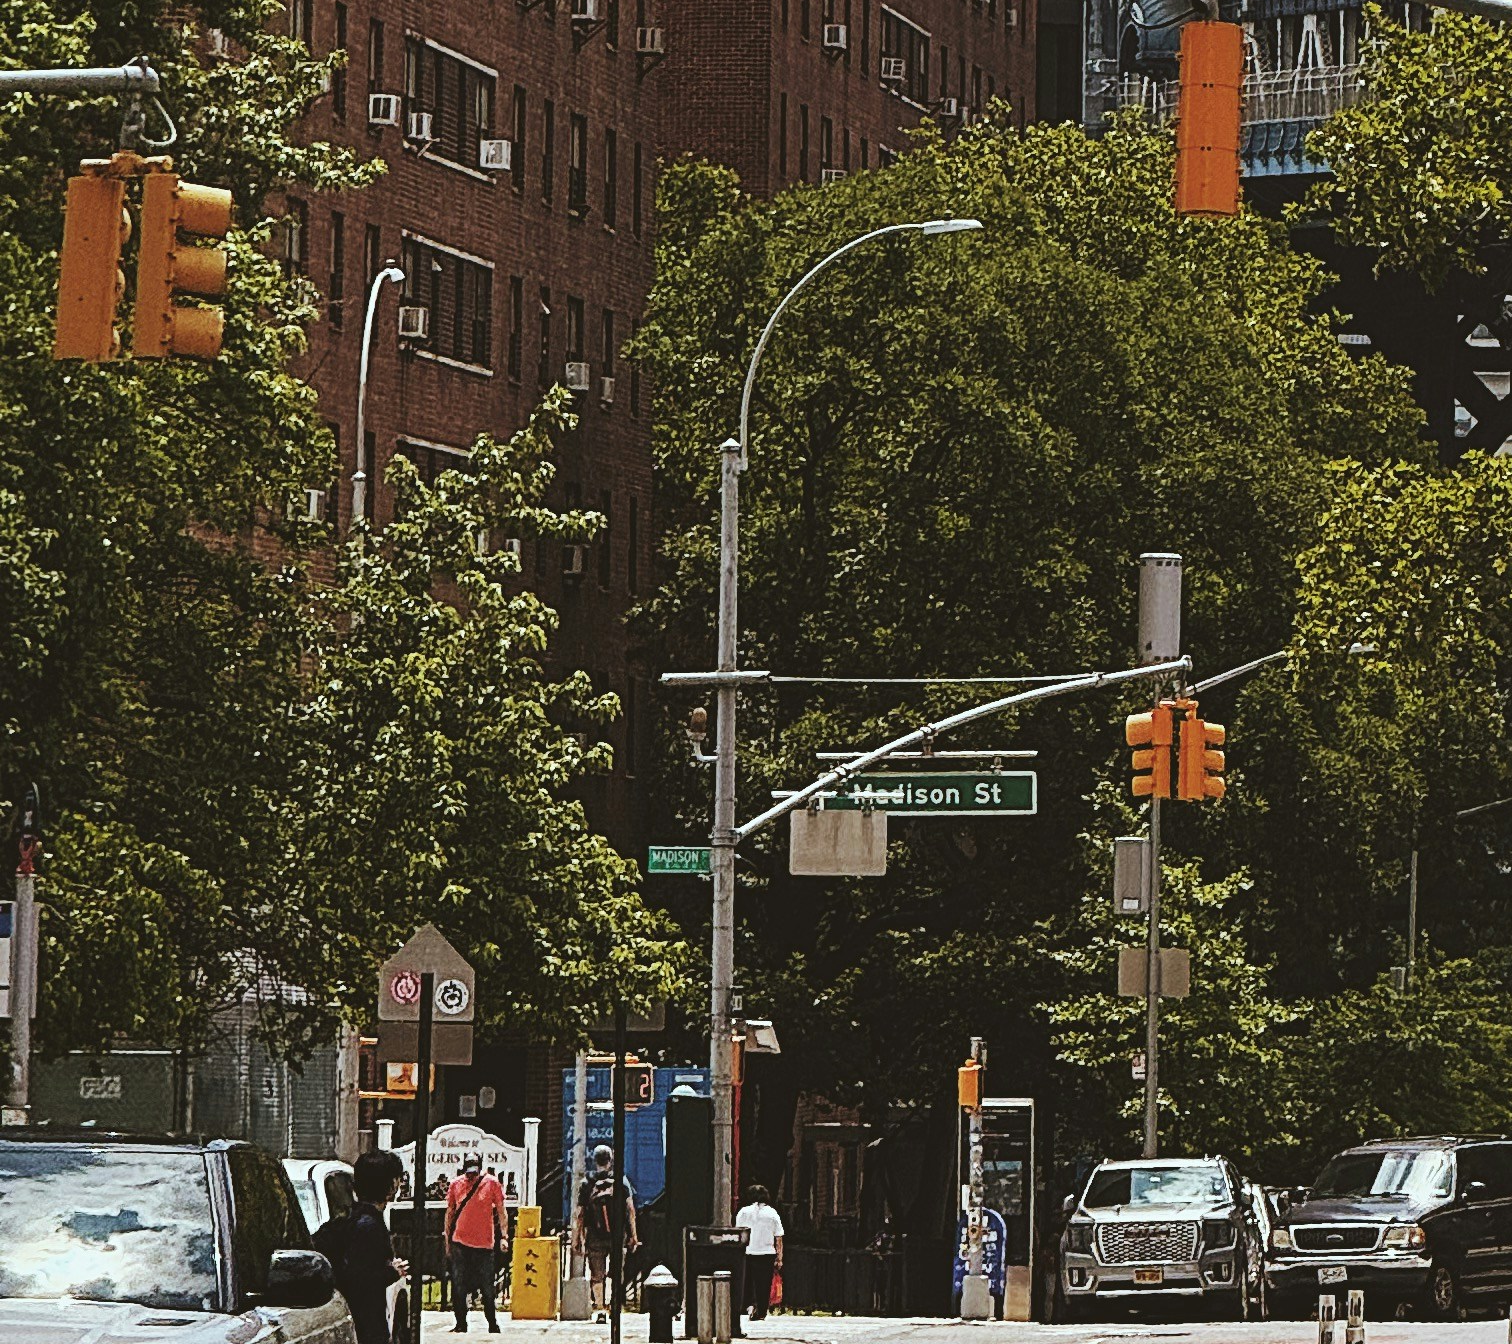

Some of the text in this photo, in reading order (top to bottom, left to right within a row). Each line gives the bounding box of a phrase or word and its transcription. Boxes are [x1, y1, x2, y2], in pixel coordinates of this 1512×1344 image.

[853, 782, 1002, 805] Madison St
[651, 850, 699, 863] MADISON
[639, 1073, 650, 1098] 2
